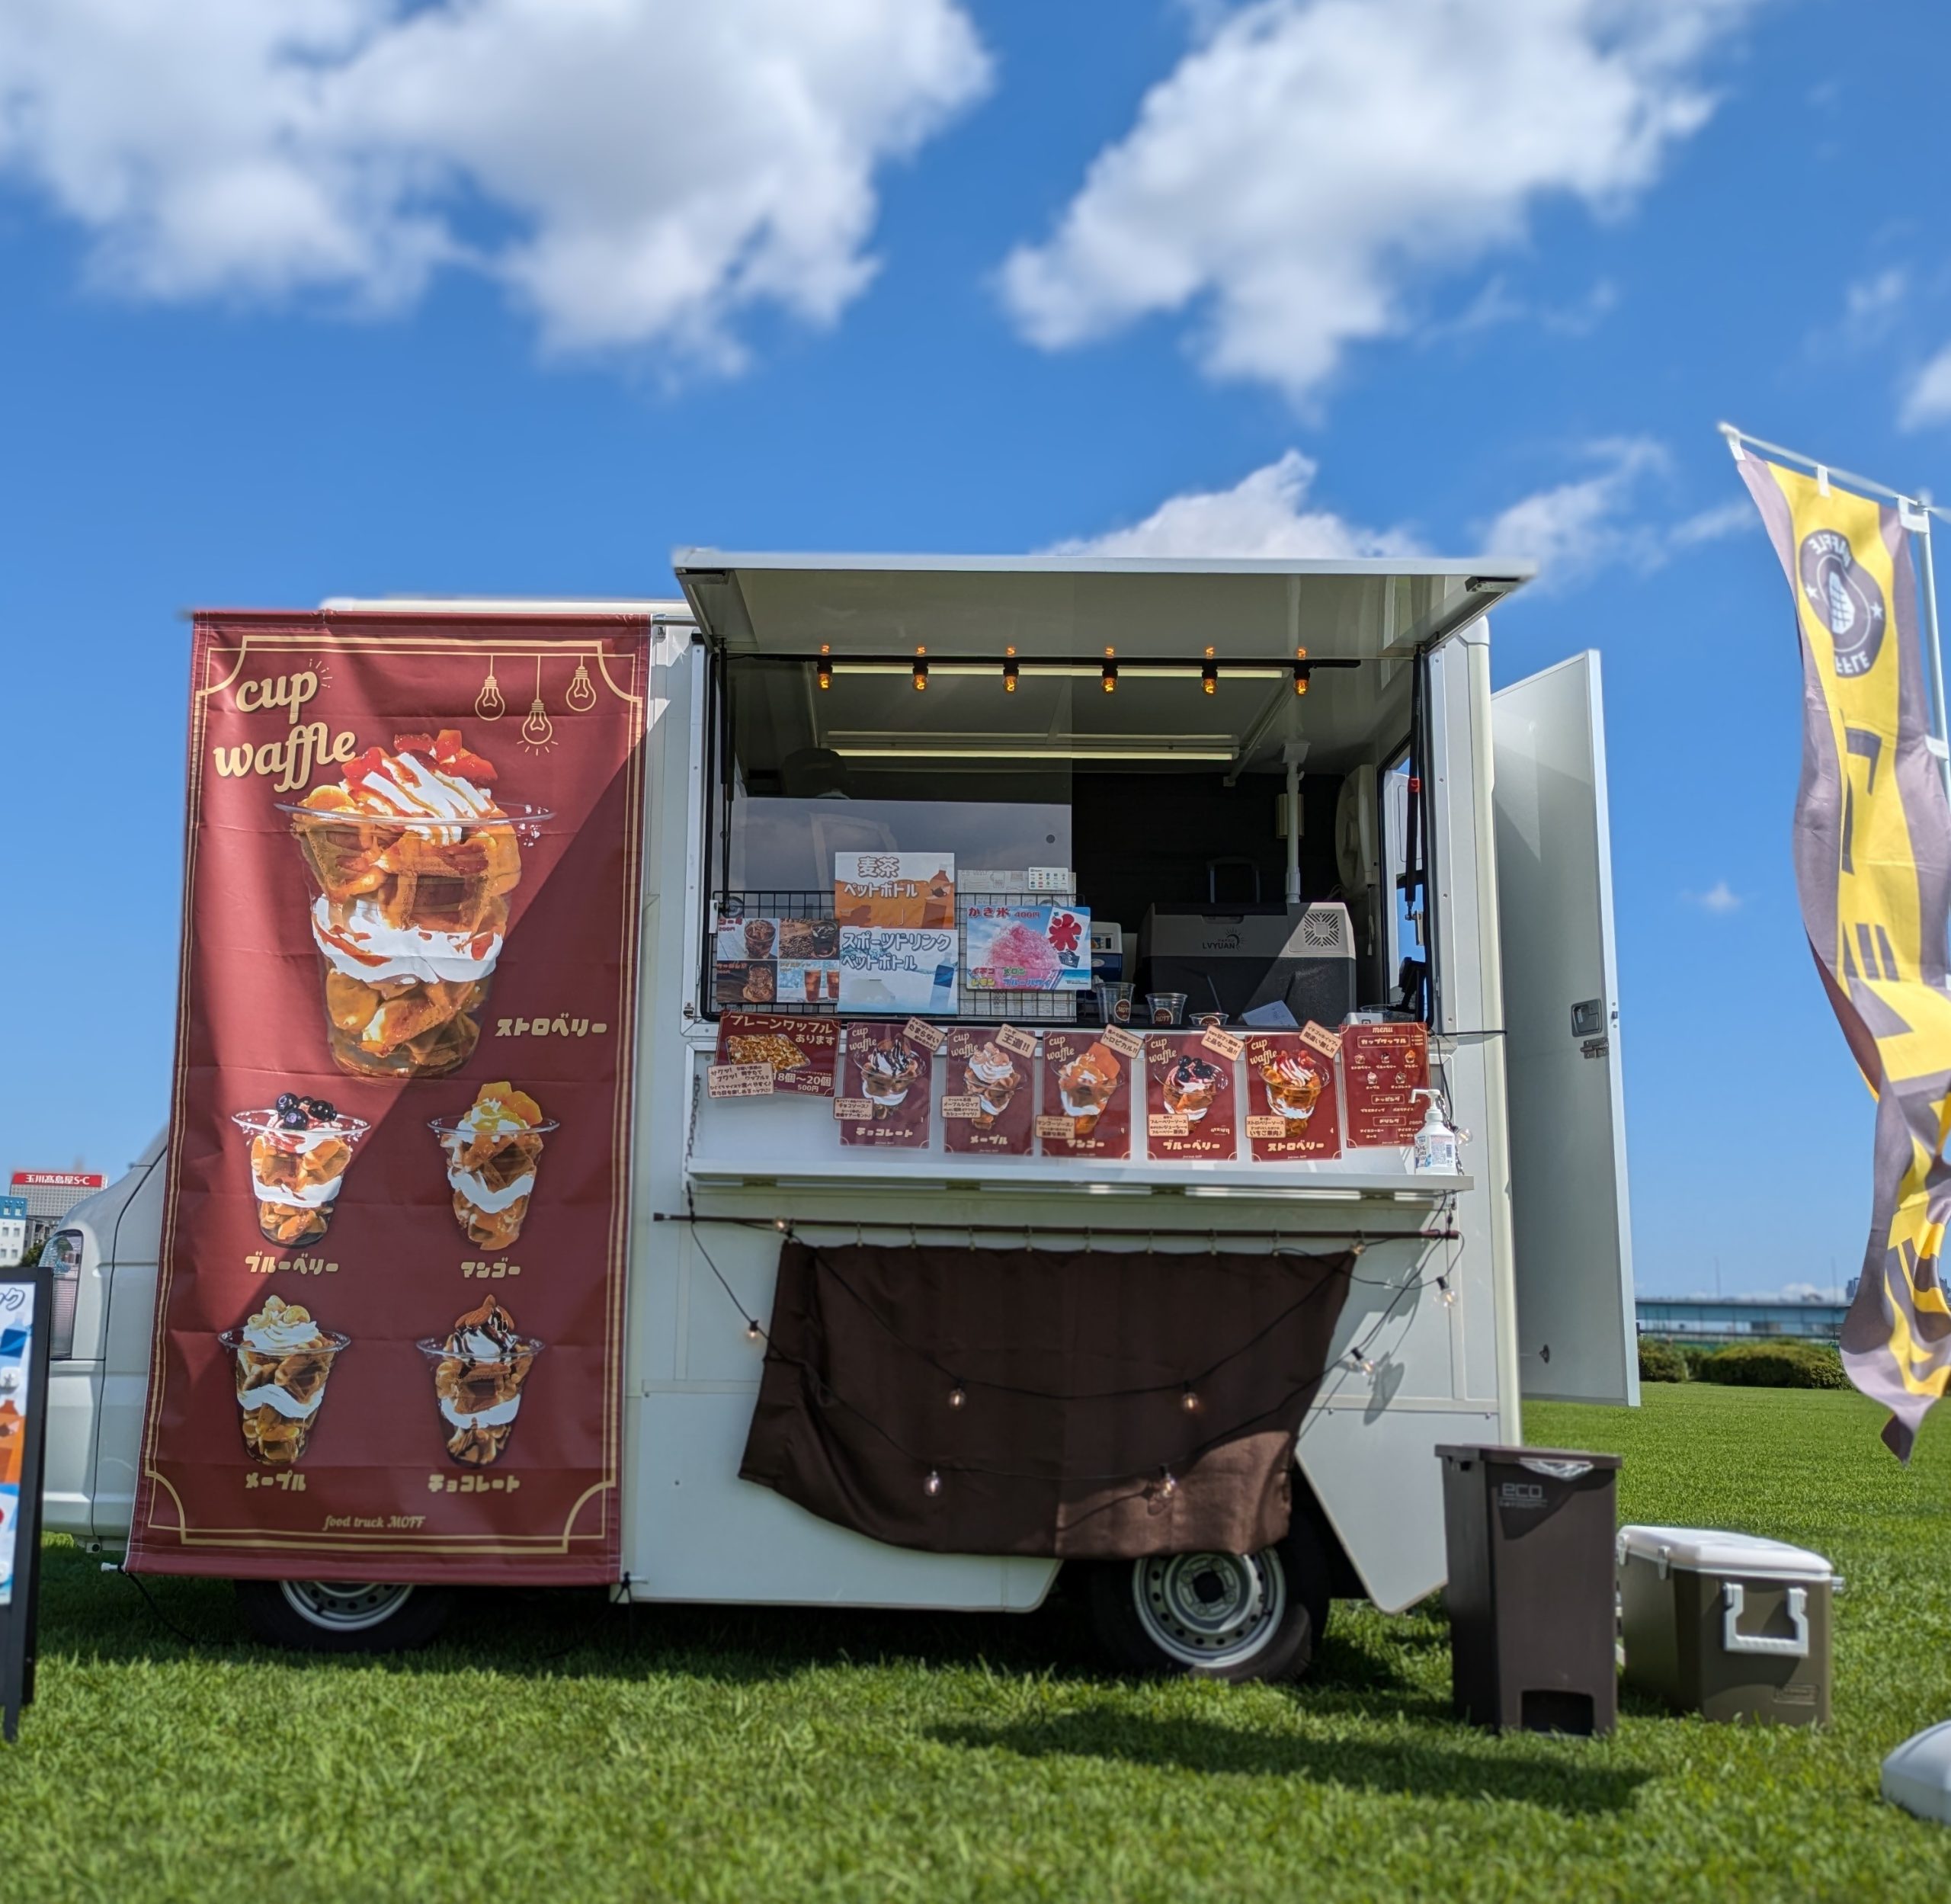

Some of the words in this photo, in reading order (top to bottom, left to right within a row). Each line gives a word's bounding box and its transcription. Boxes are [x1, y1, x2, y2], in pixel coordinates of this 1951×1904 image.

[235, 670, 318, 723] cup
[213, 721, 357, 793] waffle
[857, 856, 900, 878] 麦茶
[844, 882, 918, 899] ペットボトル
[968, 907, 1011, 919] かき氷
[842, 931, 952, 952] スポーツドリンク
[841, 953, 918, 971] ペットボトル
[1003, 967, 1027, 976] メロン
[971, 978, 995, 987] レモン
[1002, 976, 1052, 988] ブルーハワイ
[495, 1012, 608, 1037] ストロベリー
[730, 1015, 834, 1034] プレーンワッフル
[851, 1027, 869, 1038] cup
[795, 1034, 836, 1046] あります
[908, 1024, 940, 1043] たまらない
[953, 1033, 969, 1044] cup
[1049, 1036, 1065, 1047] cup
[849, 1037, 876, 1052] waffle
[1001, 1032, 1030, 1052] 王道!!
[1103, 1034, 1138, 1054] トロピカル!!
[1151, 1038, 1168, 1050] cup
[1205, 1035, 1238, 1055] 上品な一品!!
[1251, 1039, 1267, 1050] cup
[950, 1043, 979, 1059] waffle
[1046, 1047, 1075, 1062] waffle
[1148, 1049, 1177, 1065] waffle
[1249, 1050, 1278, 1066] waffle
[856, 1127, 913, 1138] チョコレート
[970, 1134, 1008, 1145] メープル
[1067, 1138, 1105, 1148] マンゴー
[1163, 1139, 1220, 1150] ブルーベリー
[1267, 1140, 1325, 1152] ストロベリー
[245, 1250, 338, 1276] ブルーベリー
[460, 1256, 521, 1278] マンゴー
[245, 1472, 306, 1492] メープル
[428, 1474, 520, 1493] チョコレート
[1501, 1482, 1543, 1499] eco
[322, 1515, 351, 1531] food
[354, 1515, 385, 1528] truck
